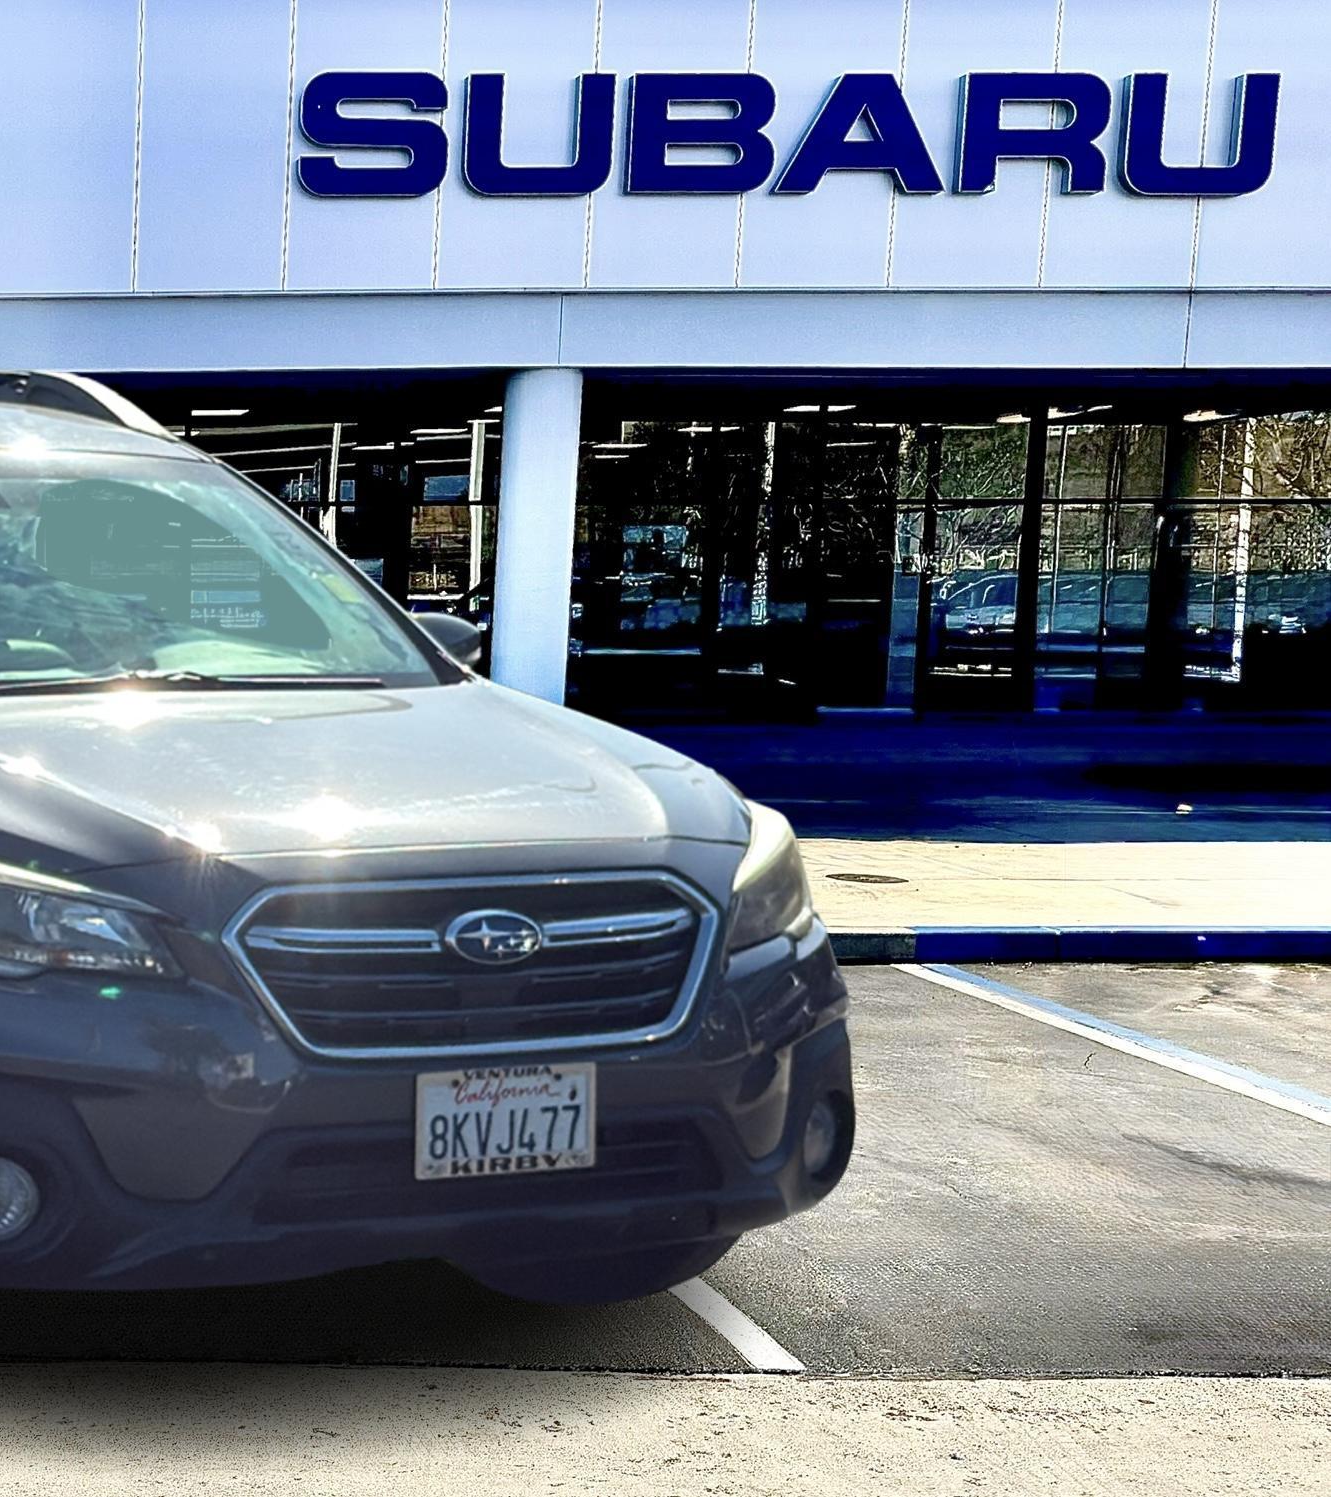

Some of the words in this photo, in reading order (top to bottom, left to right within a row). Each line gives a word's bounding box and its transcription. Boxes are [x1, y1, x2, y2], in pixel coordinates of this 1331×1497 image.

[296, 70, 1282, 197] SUBARU
[463, 1065, 554, 1081] VENTURA
[453, 1074, 561, 1108] California
[429, 1104, 581, 1160] 8KVJ477
[450, 1151, 563, 1175] KIRBY
